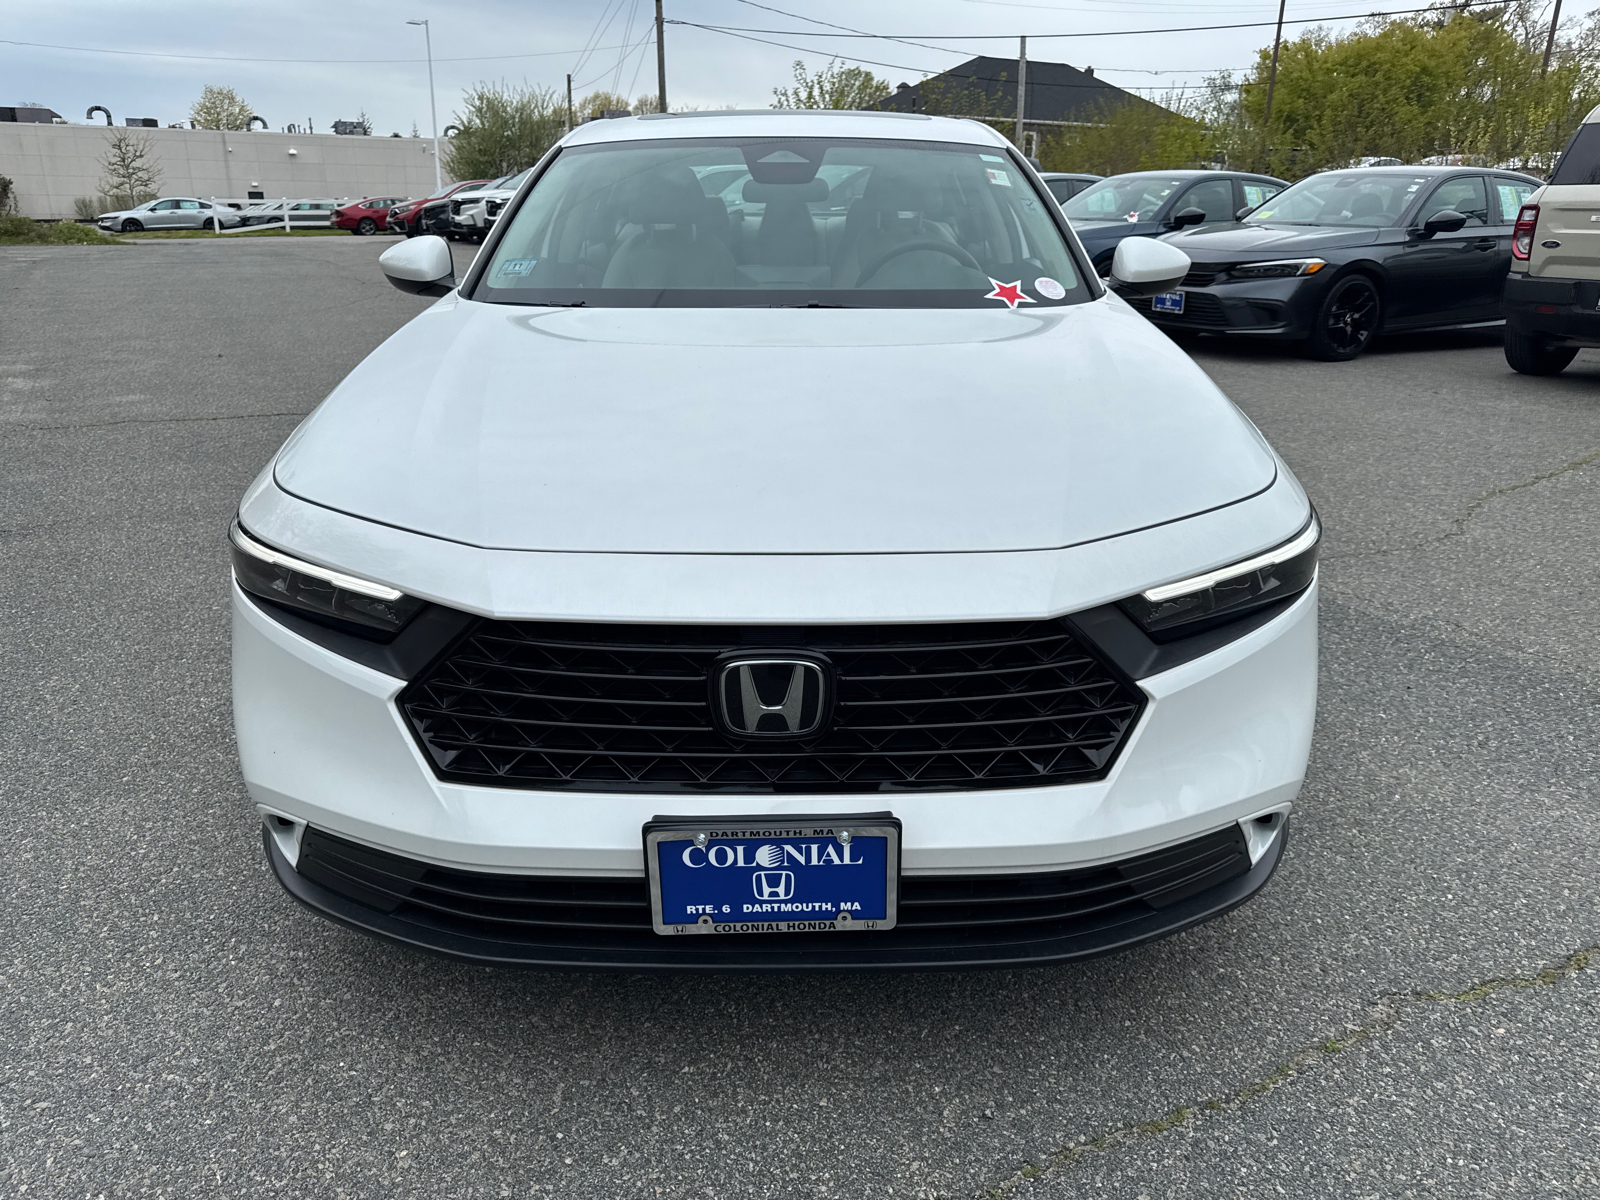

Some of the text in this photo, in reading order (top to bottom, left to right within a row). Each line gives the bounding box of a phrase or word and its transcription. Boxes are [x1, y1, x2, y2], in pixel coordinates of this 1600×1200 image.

[709, 828, 835, 838] DARTMOUTH, MA
[682, 843, 864, 868] COLONIAL
[686, 901, 862, 914] RTE. 6 DARTMOUTH, MA
[713, 921, 837, 933] COLONIAL HONDA
